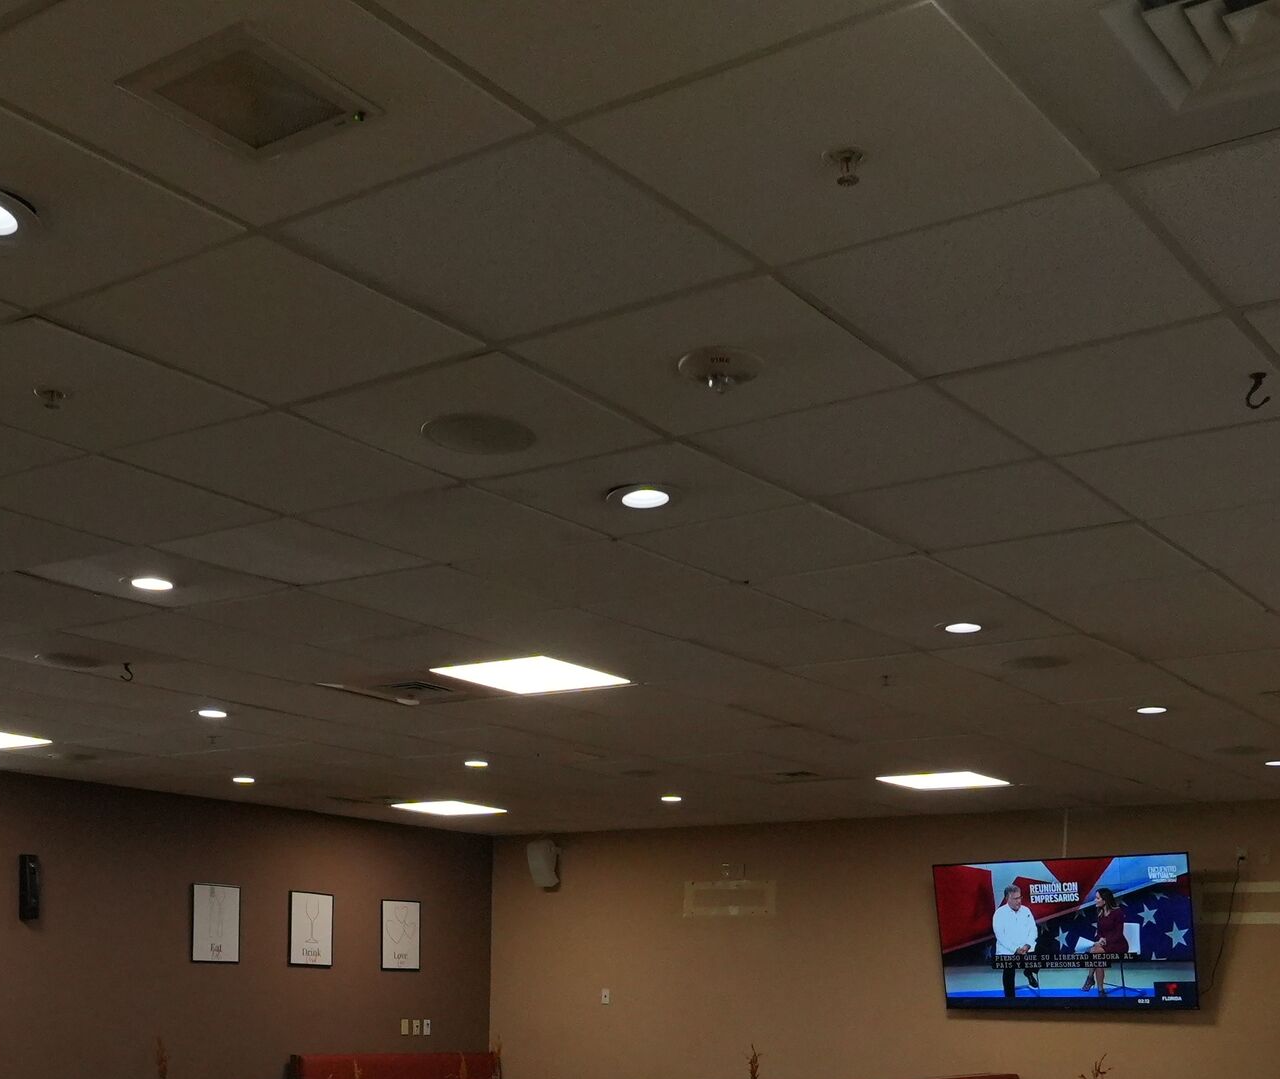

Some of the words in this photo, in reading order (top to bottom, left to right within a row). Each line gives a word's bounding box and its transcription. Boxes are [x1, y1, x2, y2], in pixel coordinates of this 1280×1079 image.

[1029, 882, 1062, 893] REUNIÓN
[1062, 882, 1078, 892] CON
[1030, 893, 1080, 904] EMPRESARIOS
[302, 947, 322, 957] Drink
[393, 951, 409, 960] Love
